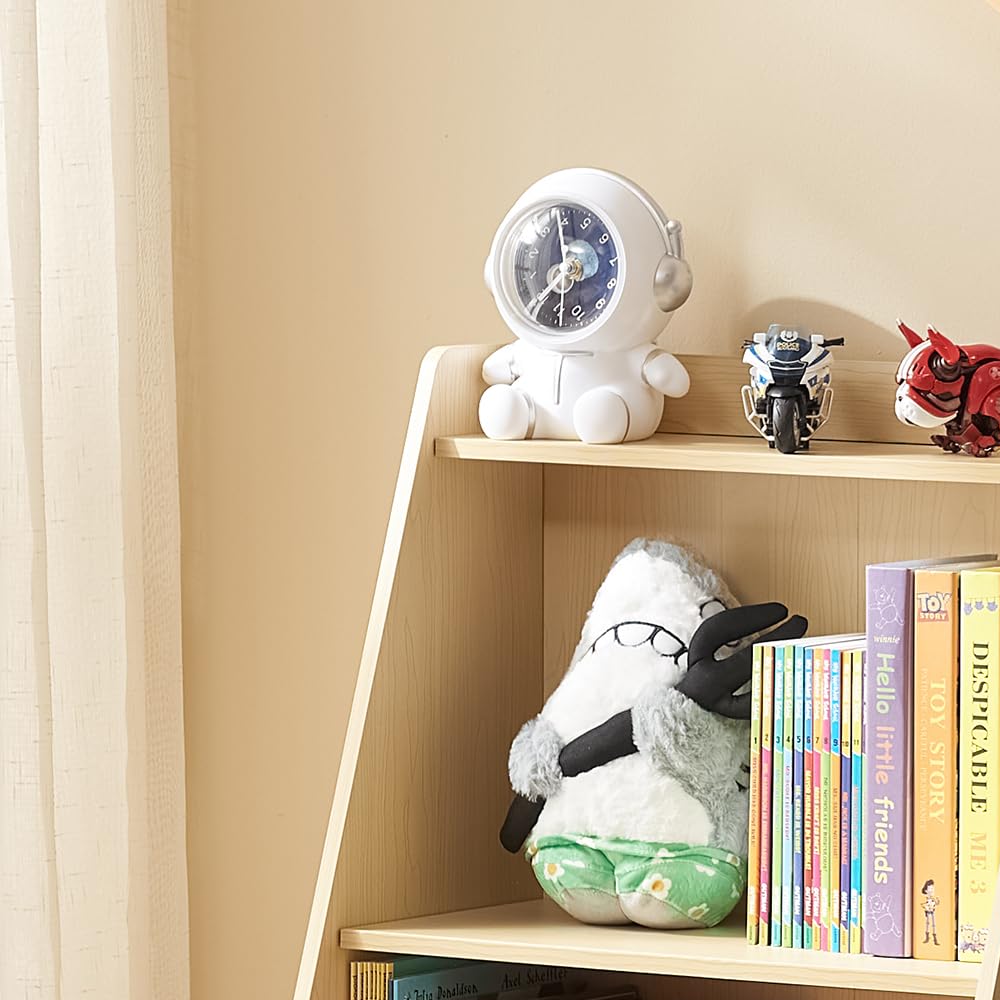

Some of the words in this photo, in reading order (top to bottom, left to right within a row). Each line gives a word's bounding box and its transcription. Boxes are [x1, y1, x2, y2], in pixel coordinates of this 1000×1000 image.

[580, 218, 591, 230] 5
[599, 233, 609, 244] 6
[609, 257, 619, 266] 7
[607, 278, 617, 289] 8
[595, 298, 606, 309] 9
[571, 305, 586, 321] 10
[917, 592, 952, 613] TOY
[919, 612, 948, 620] STORY
[873, 635, 900, 645] winnie
[876, 652, 896, 714] Hello
[929, 679, 945, 729] TOY
[970, 642, 989, 812] DESPICABLE
[875, 725, 896, 785] little
[929, 741, 945, 824] STORY
[874, 796, 894, 884] friends
[970, 832, 987, 870] ME
[970, 880, 987, 894] 3
[437, 982, 479, 1000] Donaldson
[501, 974, 521, 990] Axel
